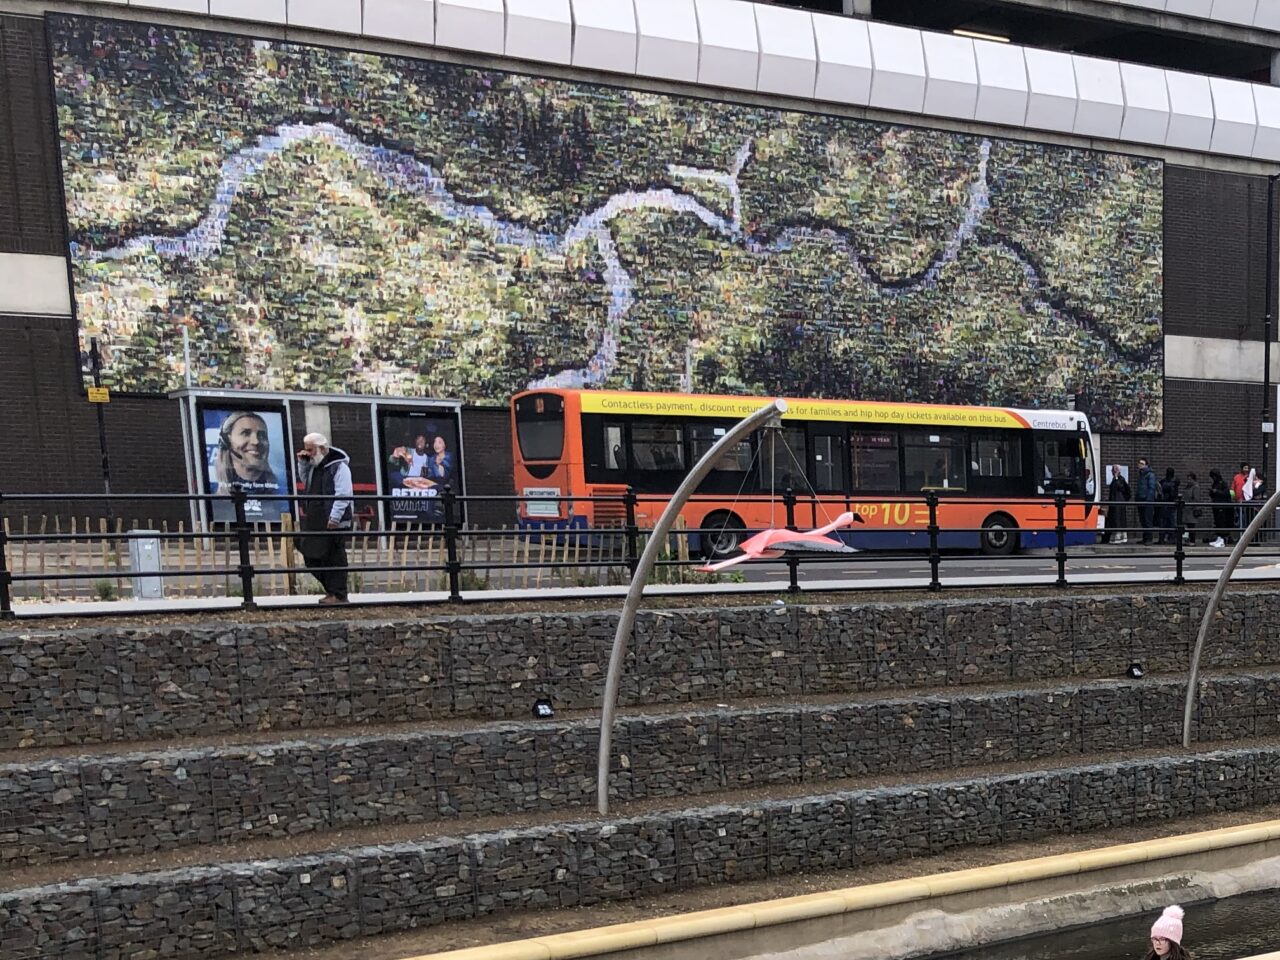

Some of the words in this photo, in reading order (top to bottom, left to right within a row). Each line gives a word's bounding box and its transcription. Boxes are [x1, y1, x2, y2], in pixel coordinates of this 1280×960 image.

[601, 398, 654, 410] Contactless
[655, 402, 697, 413] payment,
[699, 403, 736, 413] discount
[796, 407, 809, 415] for
[810, 407, 842, 417] families
[843, 409, 858, 417] and
[860, 409, 873, 419] hip
[874, 410, 889, 419] hop
[891, 411, 905, 420] day
[906, 411, 932, 420] tickets
[934, 413, 967, 421] available
[979, 414, 993, 422] this
[994, 415, 1007, 423] bus
[1032, 419, 1067, 429] Centrebus
[391, 487, 438, 497] BETTER
[392, 499, 429, 511] WITH
[855, 503, 878, 519] top
[881, 502, 910, 525] 10
